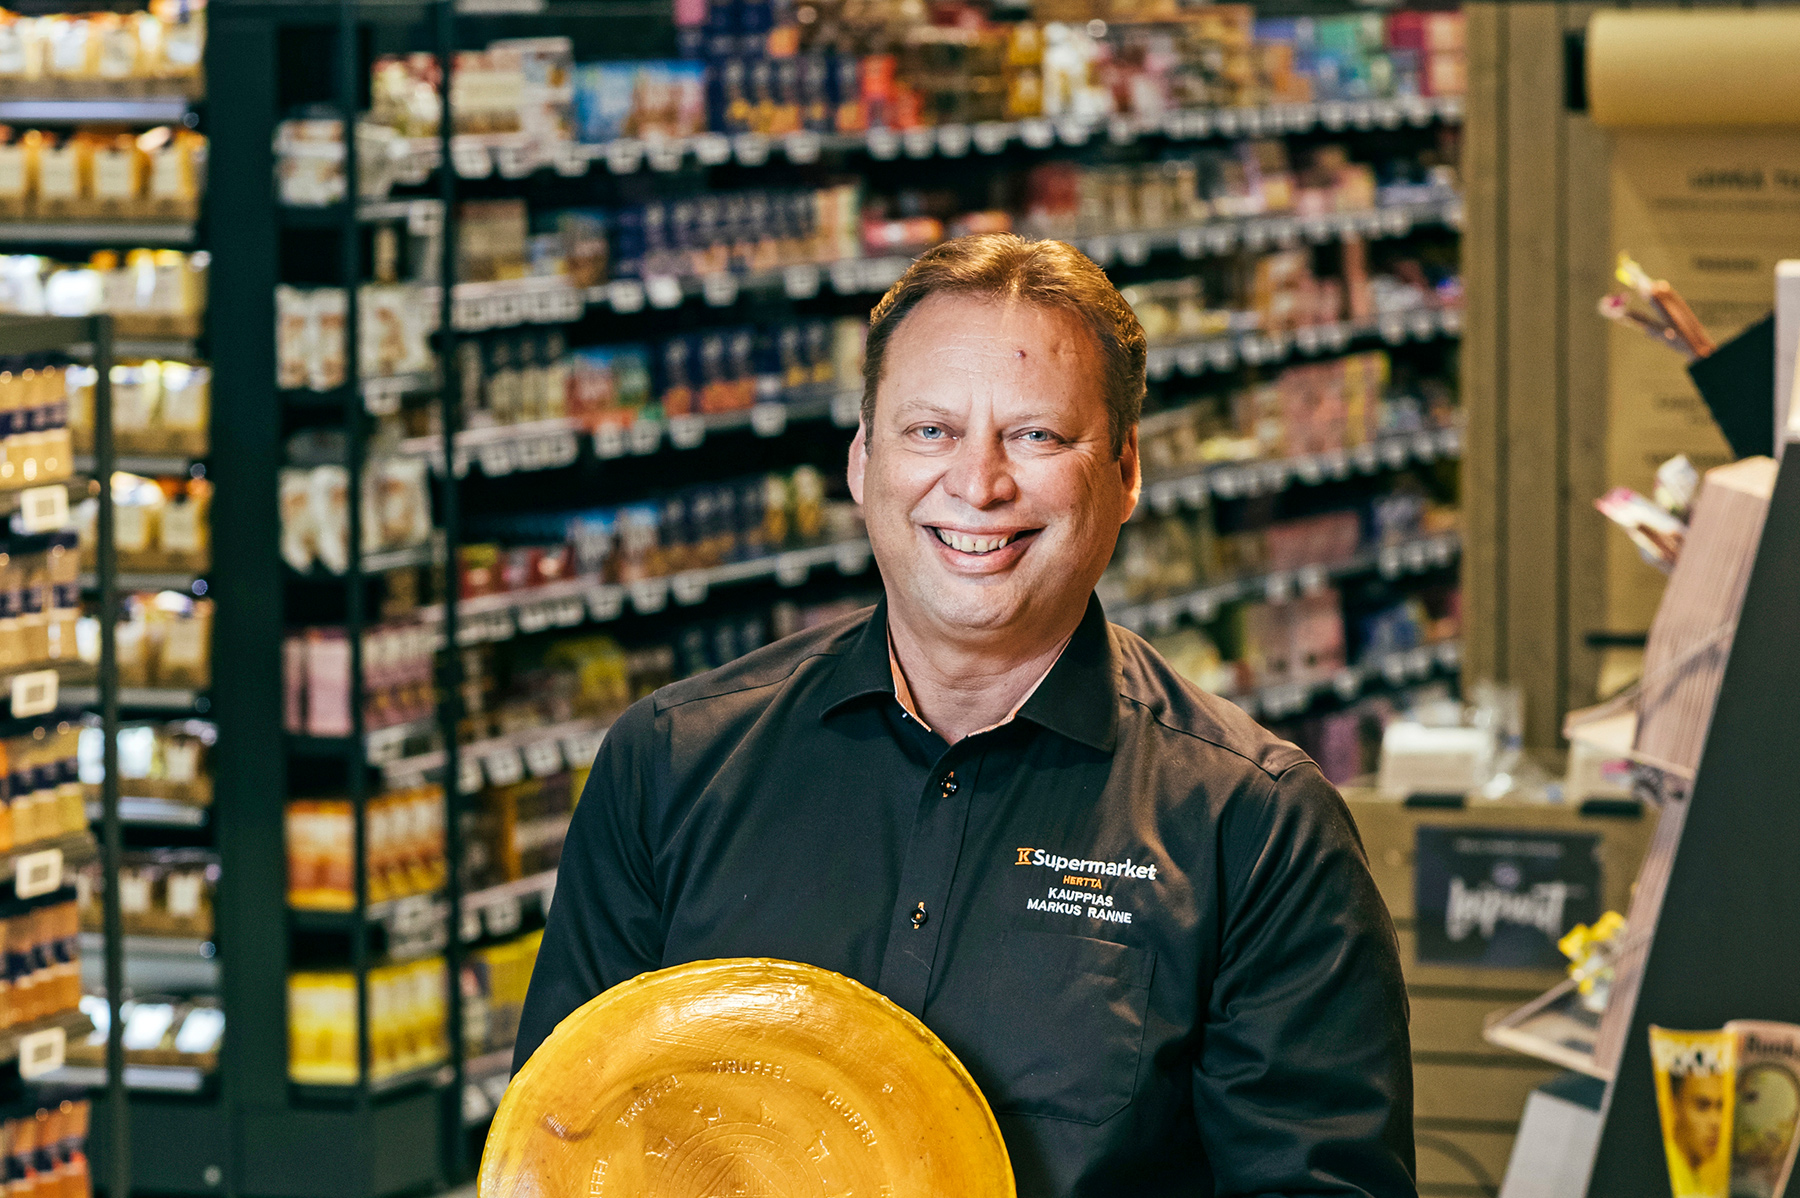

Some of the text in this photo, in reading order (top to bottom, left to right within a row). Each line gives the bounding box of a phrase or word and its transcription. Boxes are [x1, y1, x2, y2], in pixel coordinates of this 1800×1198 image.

[1032, 849, 1158, 881] Supermarket
[1062, 874, 1103, 890] HERTTA
[1047, 886, 1114, 908] KAUPPIAS
[1026, 898, 1133, 925] MARKUS RANNE
